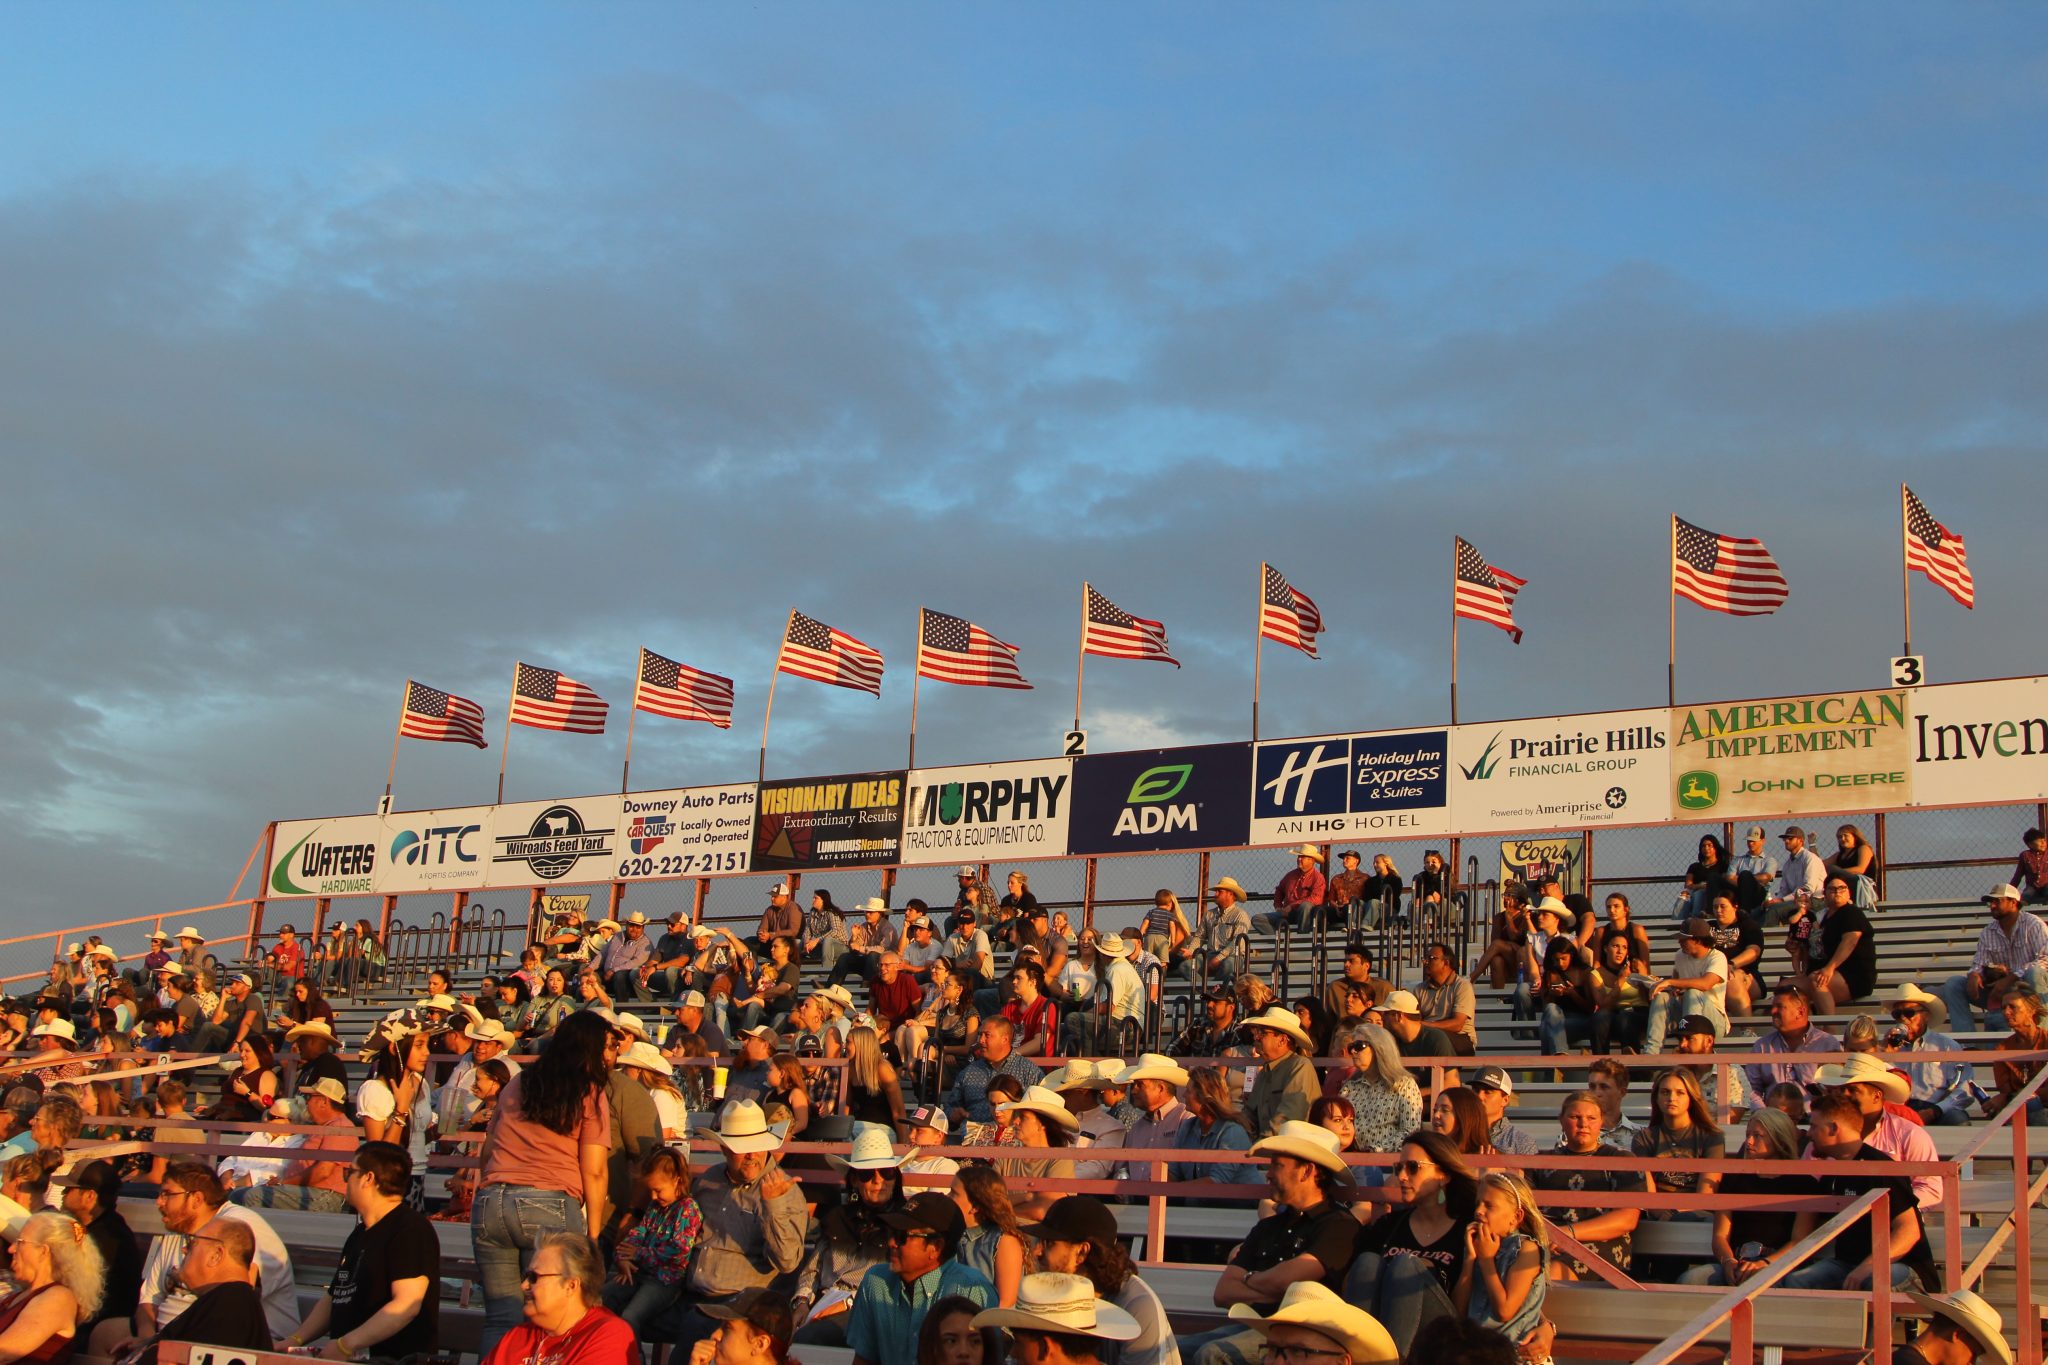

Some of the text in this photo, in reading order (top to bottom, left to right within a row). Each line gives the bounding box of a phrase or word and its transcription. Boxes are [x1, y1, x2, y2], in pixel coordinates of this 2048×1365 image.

[1895, 657, 1921, 686] 3
[1676, 693, 1906, 746] AMERICAN
[1065, 732, 1085, 755] 2
[1509, 725, 1666, 760] Prairie Hills
[1706, 728, 1877, 759] IMPLEMENT
[1915, 714, 2048, 763] Inven
[1357, 749, 1441, 766] Holiday Inn
[1357, 766, 1440, 787] Express
[1509, 758, 1637, 778] FINANCIAL GROUP
[1370, 786, 1424, 799] & Suites
[1732, 771, 1905, 794] JOHN DEERE
[381, 796, 391, 814] 1
[623, 791, 754, 814] Downey Auto Parts
[761, 779, 900, 816] VISIONARY IDEAS
[907, 774, 1068, 828] MURPHY
[783, 809, 898, 829] Extraordinary Results
[1491, 801, 1602, 818] Powered by Ameriprise
[1579, 812, 1614, 821] Financial
[681, 815, 751, 832] Locally Owned
[1112, 803, 1198, 837] ADM
[1277, 814, 1420, 834] AN IHG HOTEL
[627, 823, 676, 838] CARQUEST
[682, 830, 749, 846] and Operated
[906, 824, 1046, 849] TRACTOR & EQUIPMENT CO.
[506, 837, 604, 855] Wilroads Feed Yard
[861, 850, 893, 858] SYSTEMS
[1515, 841, 1568, 861] Coors
[302, 843, 375, 877] WATERS
[619, 851, 747, 877] 620-227-2151
[448, 870, 479, 878] COMPANY
[320, 878, 372, 893] HARDWARE
[1423, 1250, 1454, 1265] LIVE
